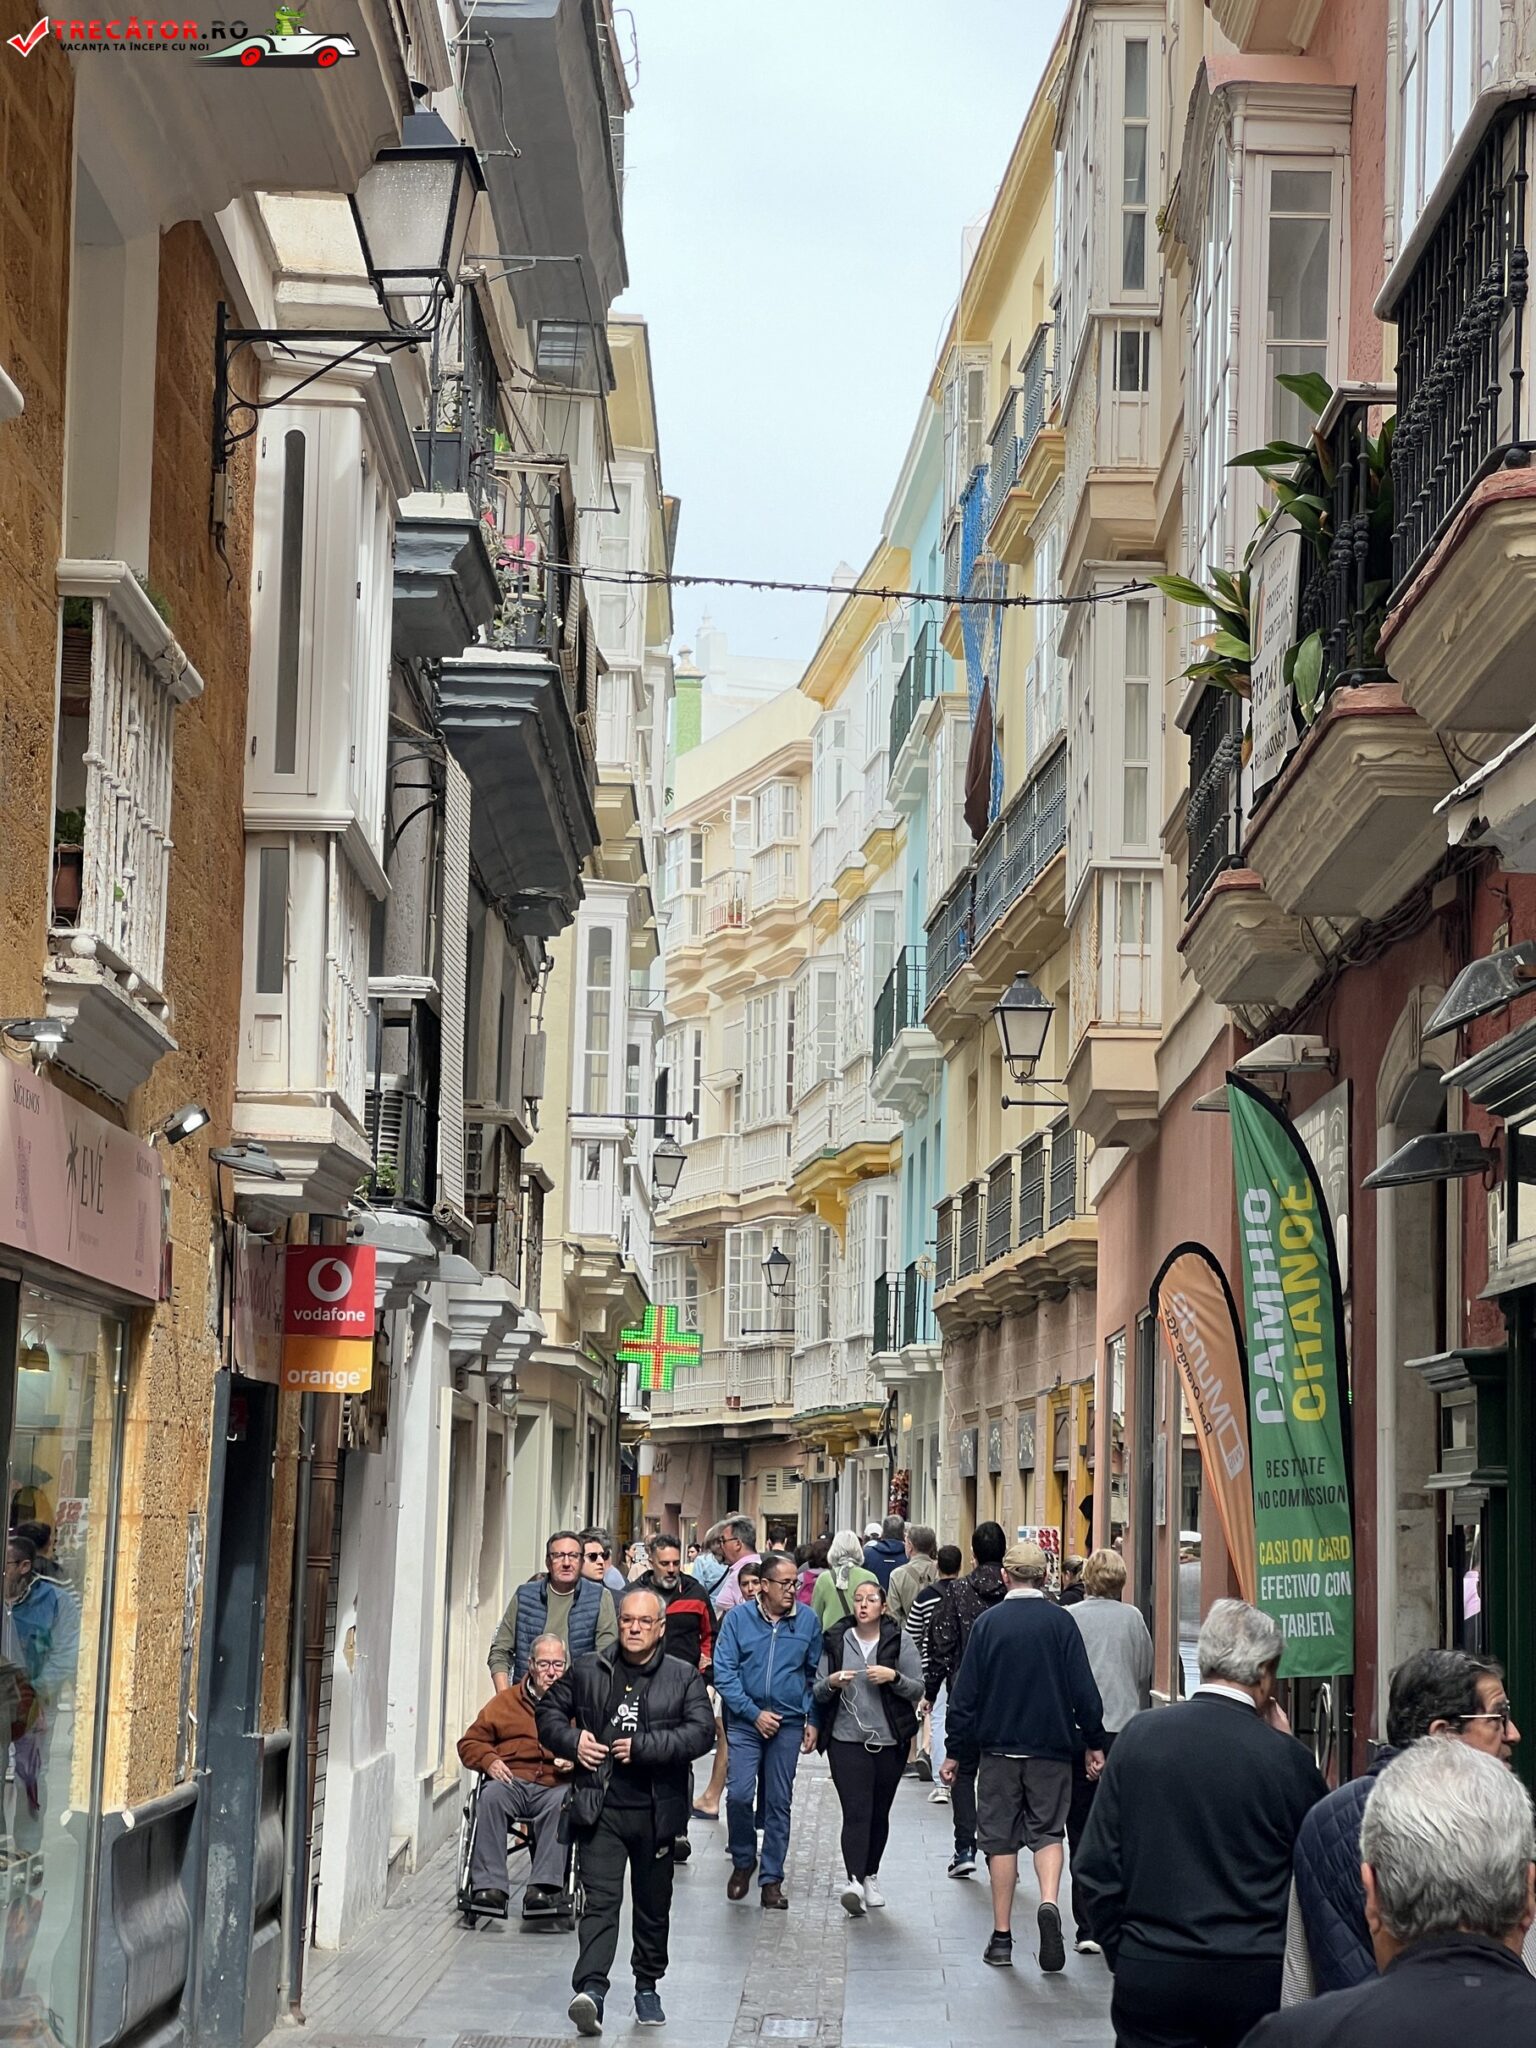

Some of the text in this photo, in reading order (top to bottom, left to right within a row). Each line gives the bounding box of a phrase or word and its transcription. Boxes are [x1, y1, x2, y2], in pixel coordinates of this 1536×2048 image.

[293, 1307, 366, 1322] vodafone
[287, 1369, 361, 1389] orange
[1266, 1456, 1327, 1478] BEST ATE
[1258, 1490, 1270, 1509] NO
[1259, 1535, 1351, 1566] CASH ON CARD
[1261, 1571, 1352, 1601] EFECTIVO CON
[1280, 1611, 1336, 1638] TARJETA
